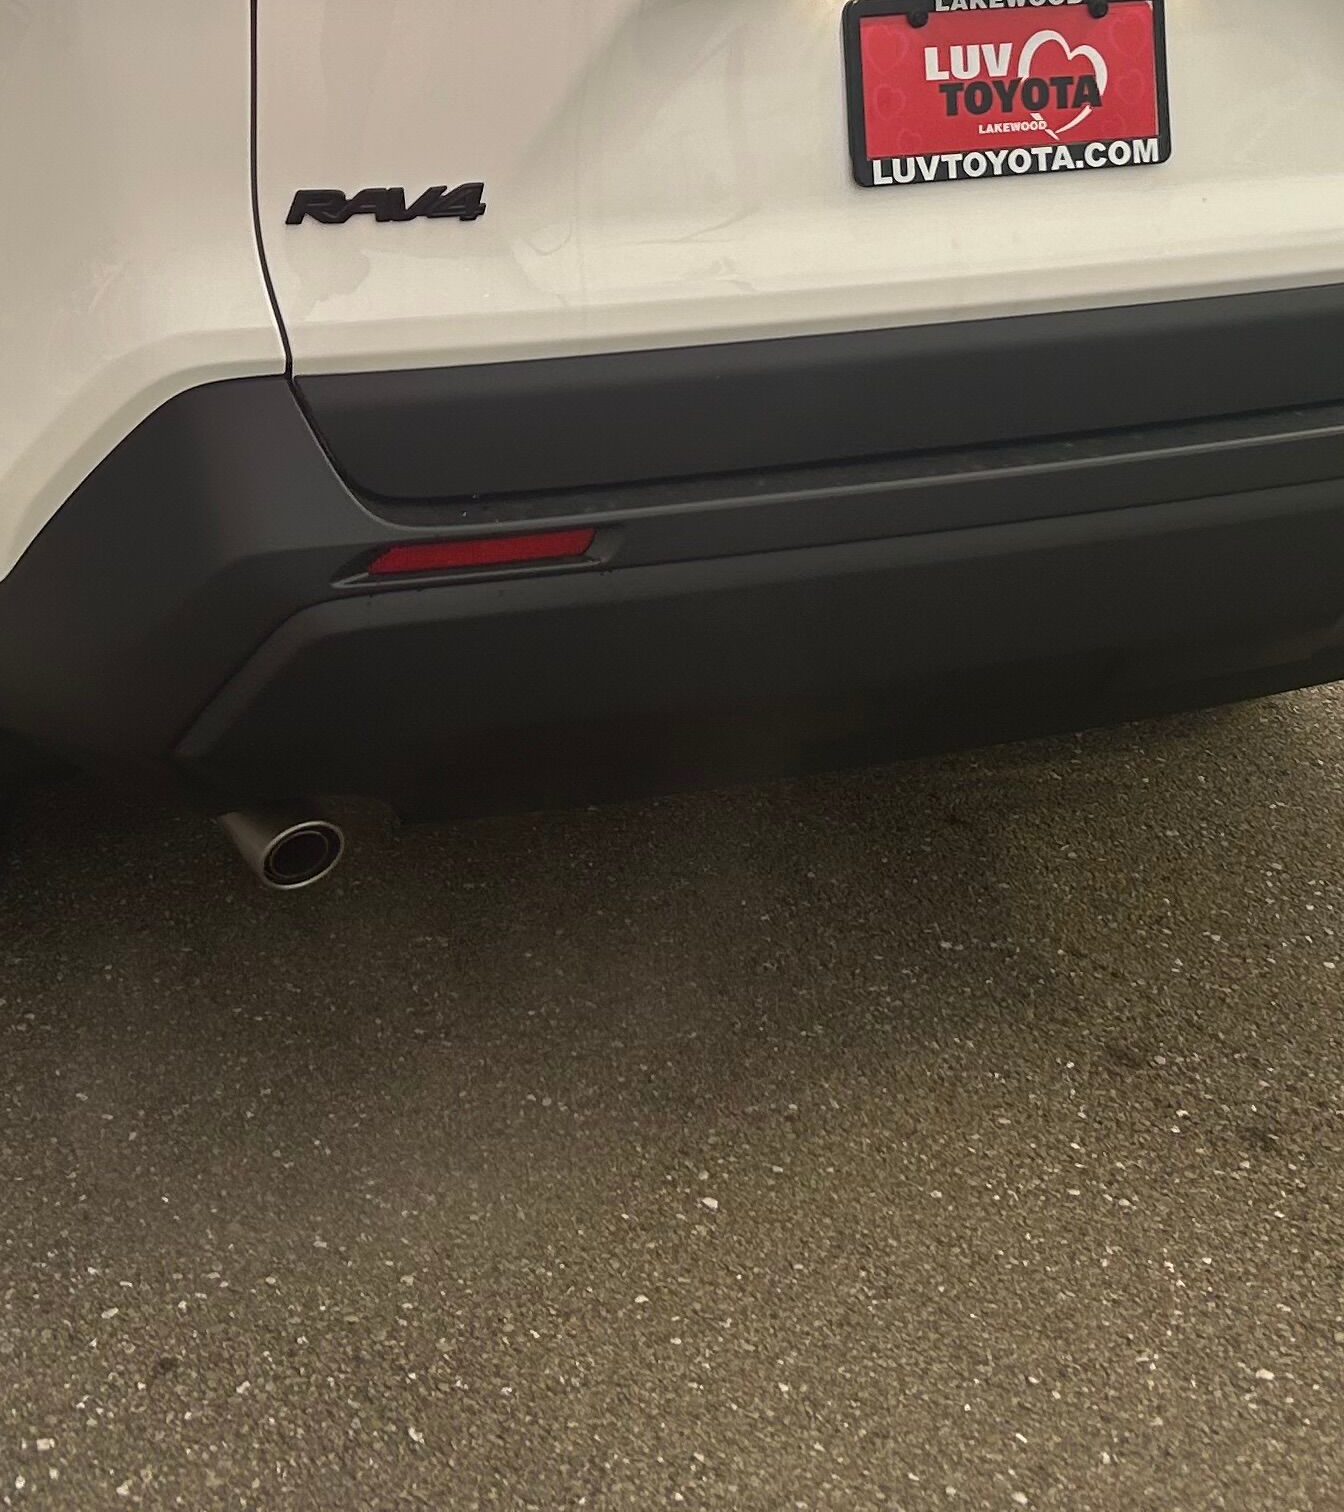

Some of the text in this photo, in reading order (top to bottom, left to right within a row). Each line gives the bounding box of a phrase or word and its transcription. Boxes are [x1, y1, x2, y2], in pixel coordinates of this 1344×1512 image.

[924, 42, 1013, 81] LUV
[939, 74, 1103, 116] TOYOTA
[978, 120, 1048, 135] LAKEWOOD
[872, 138, 1160, 186] LUVTOYOTA.COM
[285, 181, 487, 225] RAV4
